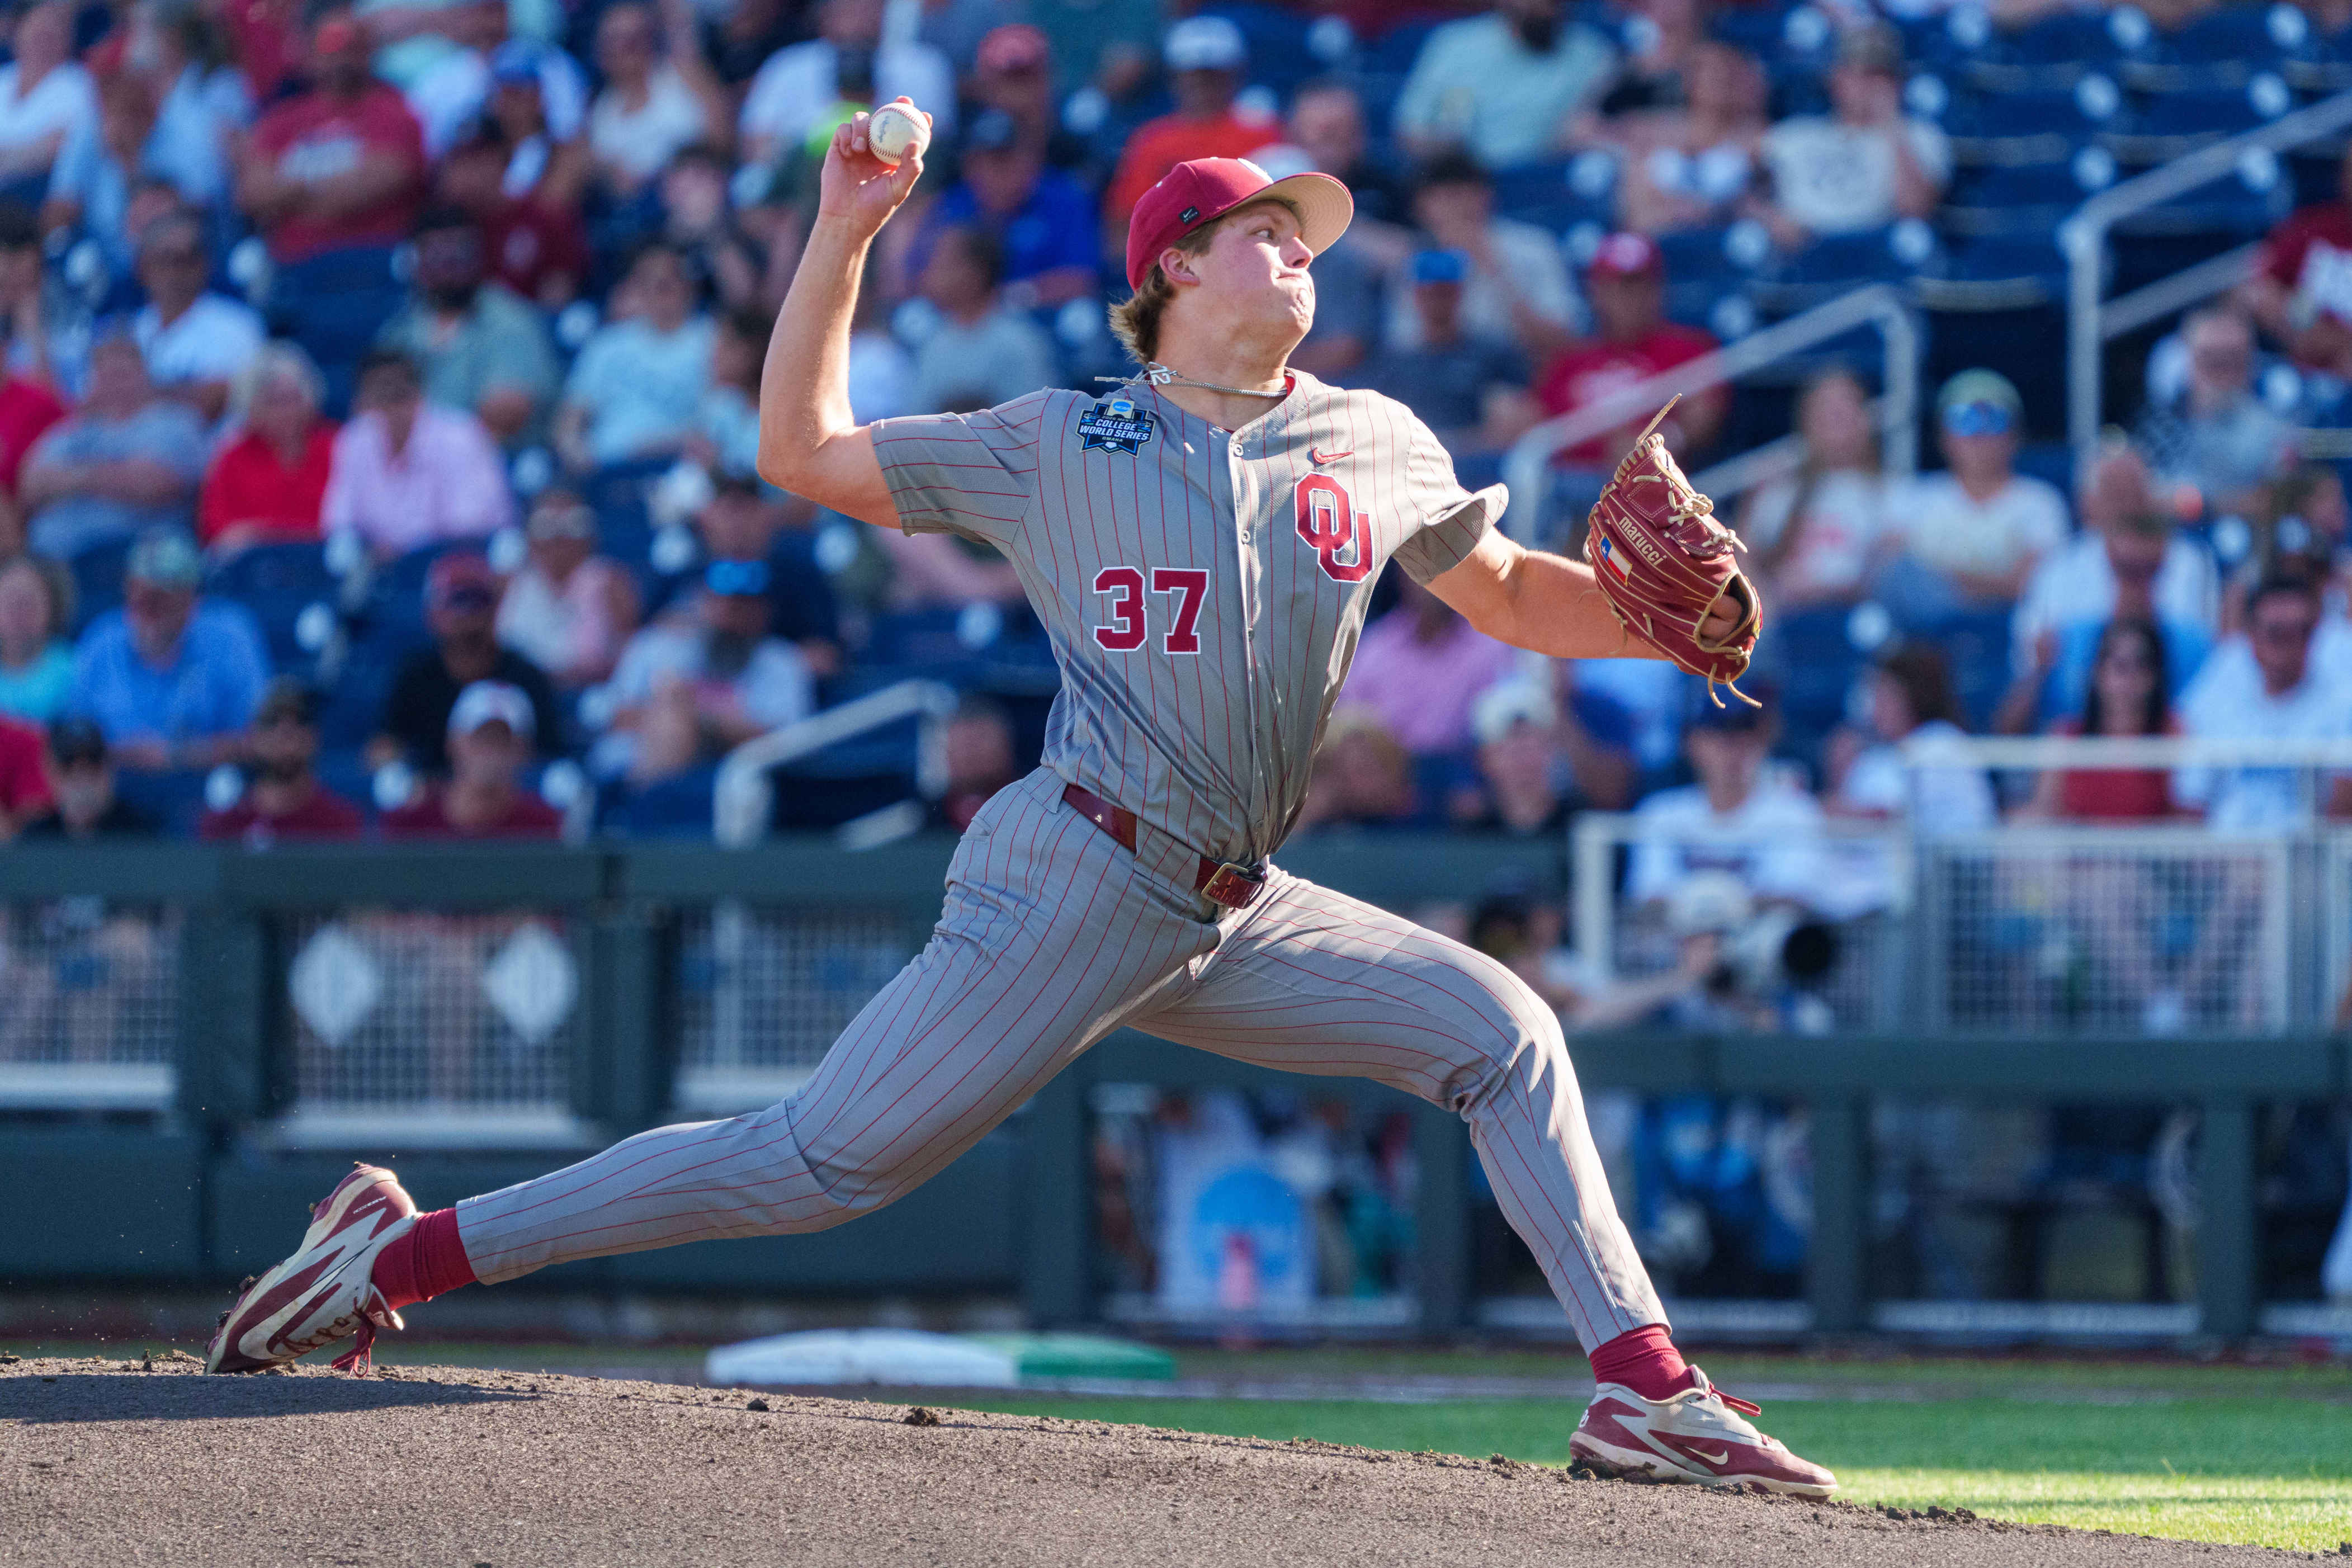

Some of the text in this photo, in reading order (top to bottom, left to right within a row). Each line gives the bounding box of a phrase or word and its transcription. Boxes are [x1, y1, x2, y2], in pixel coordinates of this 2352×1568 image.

[1079, 425, 1150, 441] WORLD SERIES
[1095, 419, 1137, 431] COLLEGE
[1294, 471, 1373, 584] OU
[1619, 516, 1668, 566] marucci
[1093, 565, 1210, 655] 37
